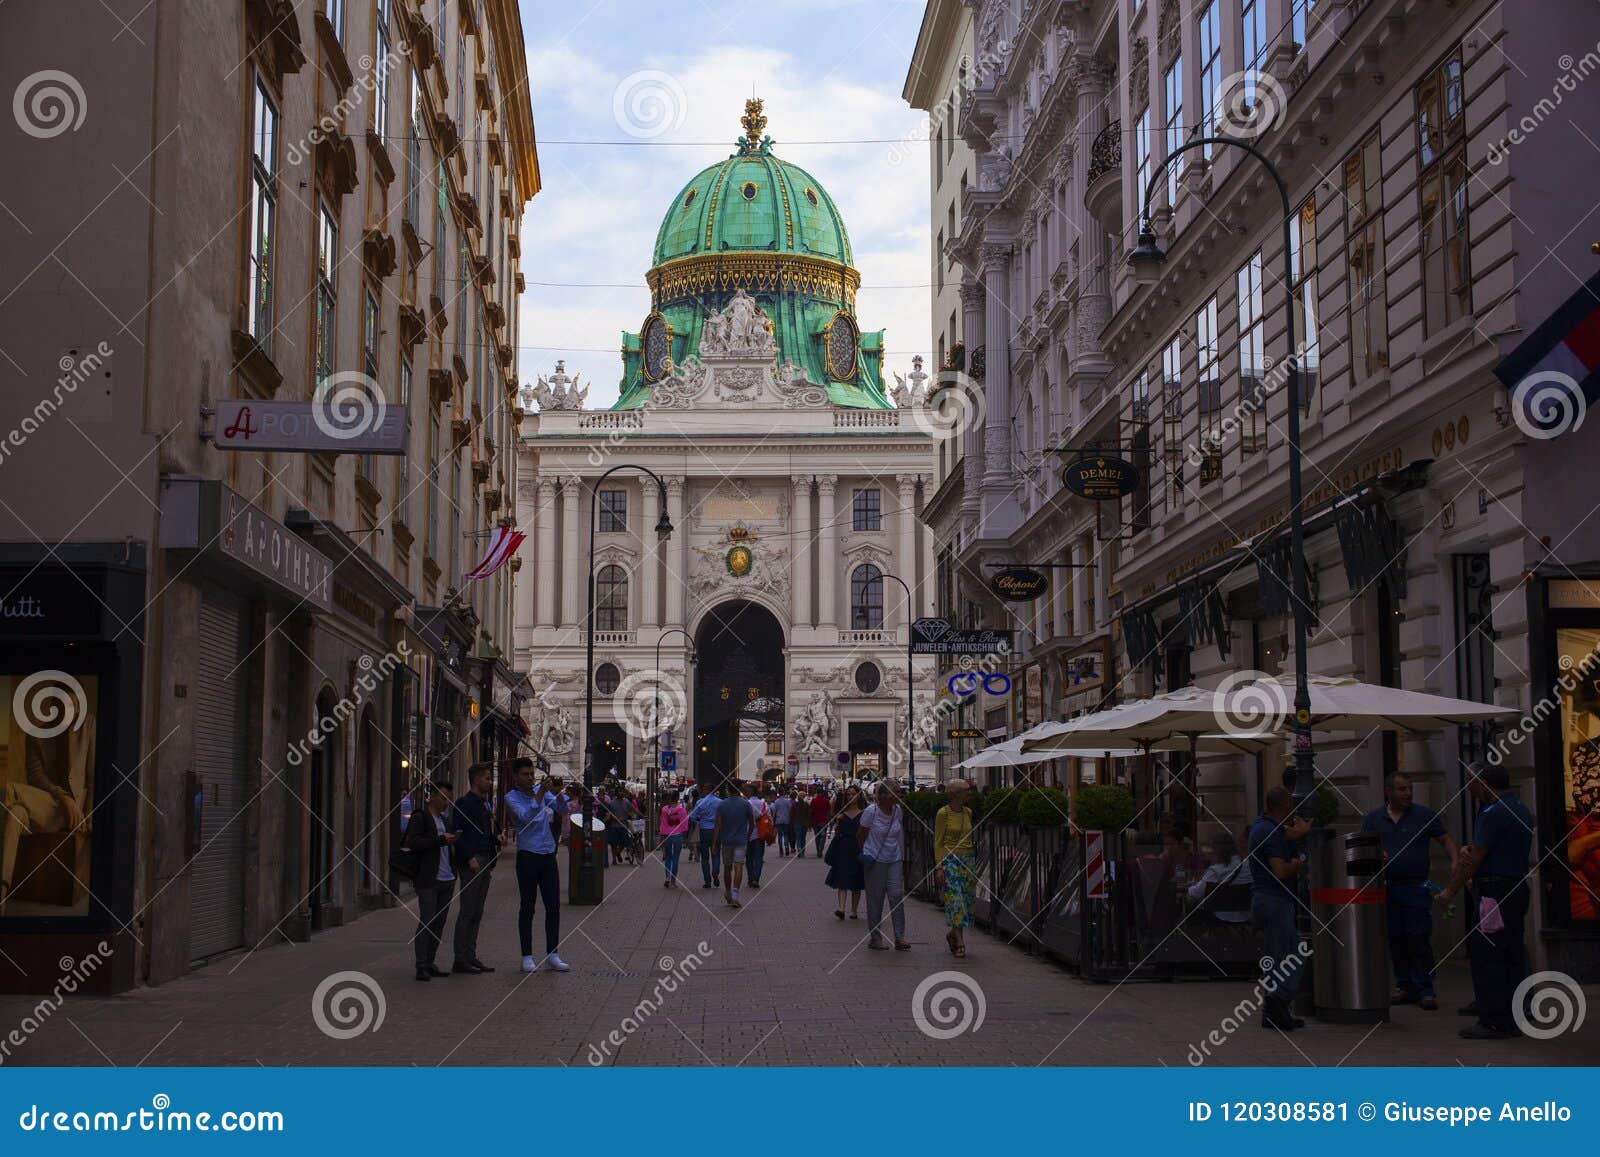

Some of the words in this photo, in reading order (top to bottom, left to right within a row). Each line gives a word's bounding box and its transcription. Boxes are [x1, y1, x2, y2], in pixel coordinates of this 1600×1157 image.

[224, 406, 399, 439] APOTE
[1080, 468, 1125, 480] DEMEL
[245, 511, 330, 602] APOTHEKE
[995, 575, 1041, 591] Chopard
[0, 595, 47, 618] utti
